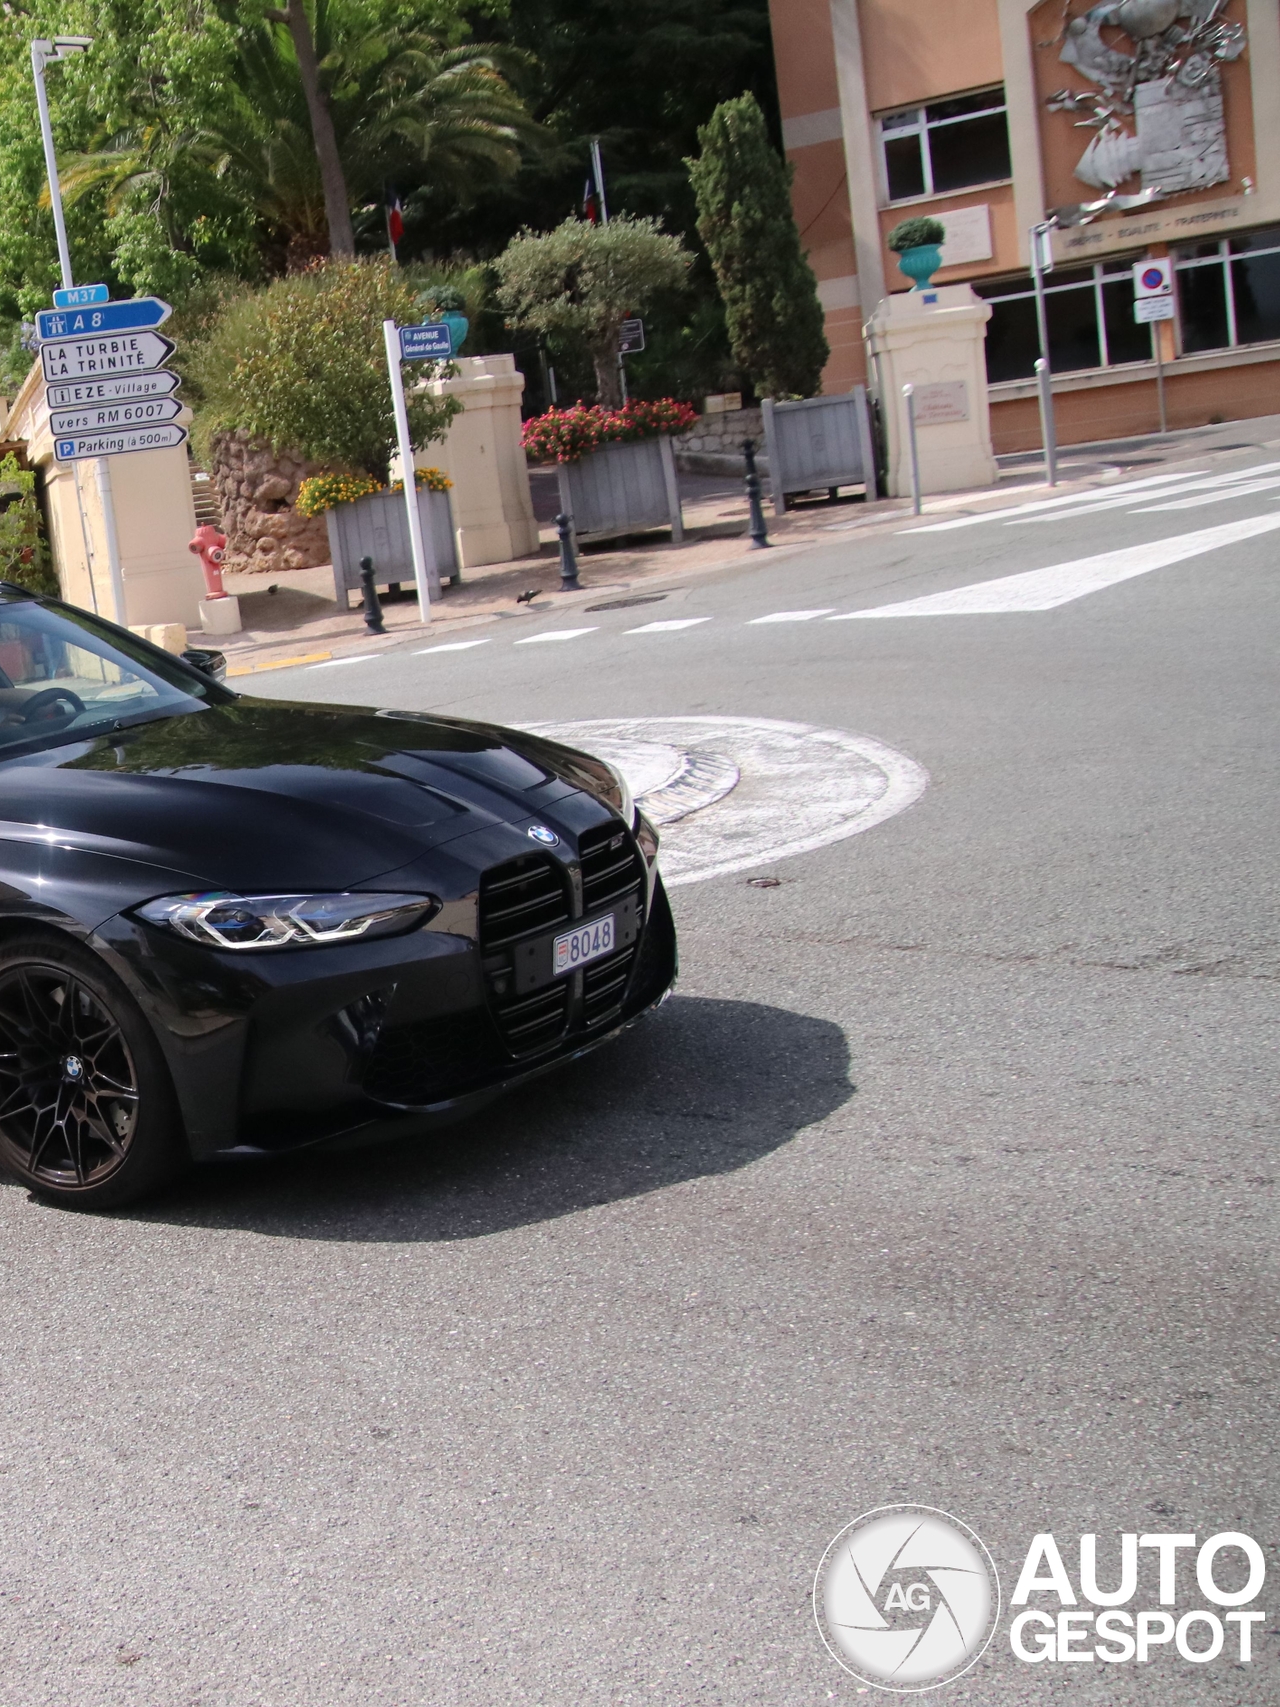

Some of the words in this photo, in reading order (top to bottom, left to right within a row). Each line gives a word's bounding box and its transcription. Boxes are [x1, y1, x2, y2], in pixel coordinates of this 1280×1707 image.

[67, 289, 96, 303] M37
[73, 314, 85, 330] A
[91, 312, 102, 327] 8
[413, 330, 439, 340] AVENUE
[48, 348, 67, 361] LA
[76, 339, 138, 357] TURBIE
[425, 342, 432, 351] de
[432, 341, 449, 350] Gaulle
[50, 363, 69, 376] LA
[77, 351, 145, 372] TRINITÉ
[58, 416, 89, 429] vers
[97, 410, 119, 424] RM
[124, 404, 164, 420] 6007
[78, 439, 124, 453] Parking
[570, 922, 611, 962] 8048
